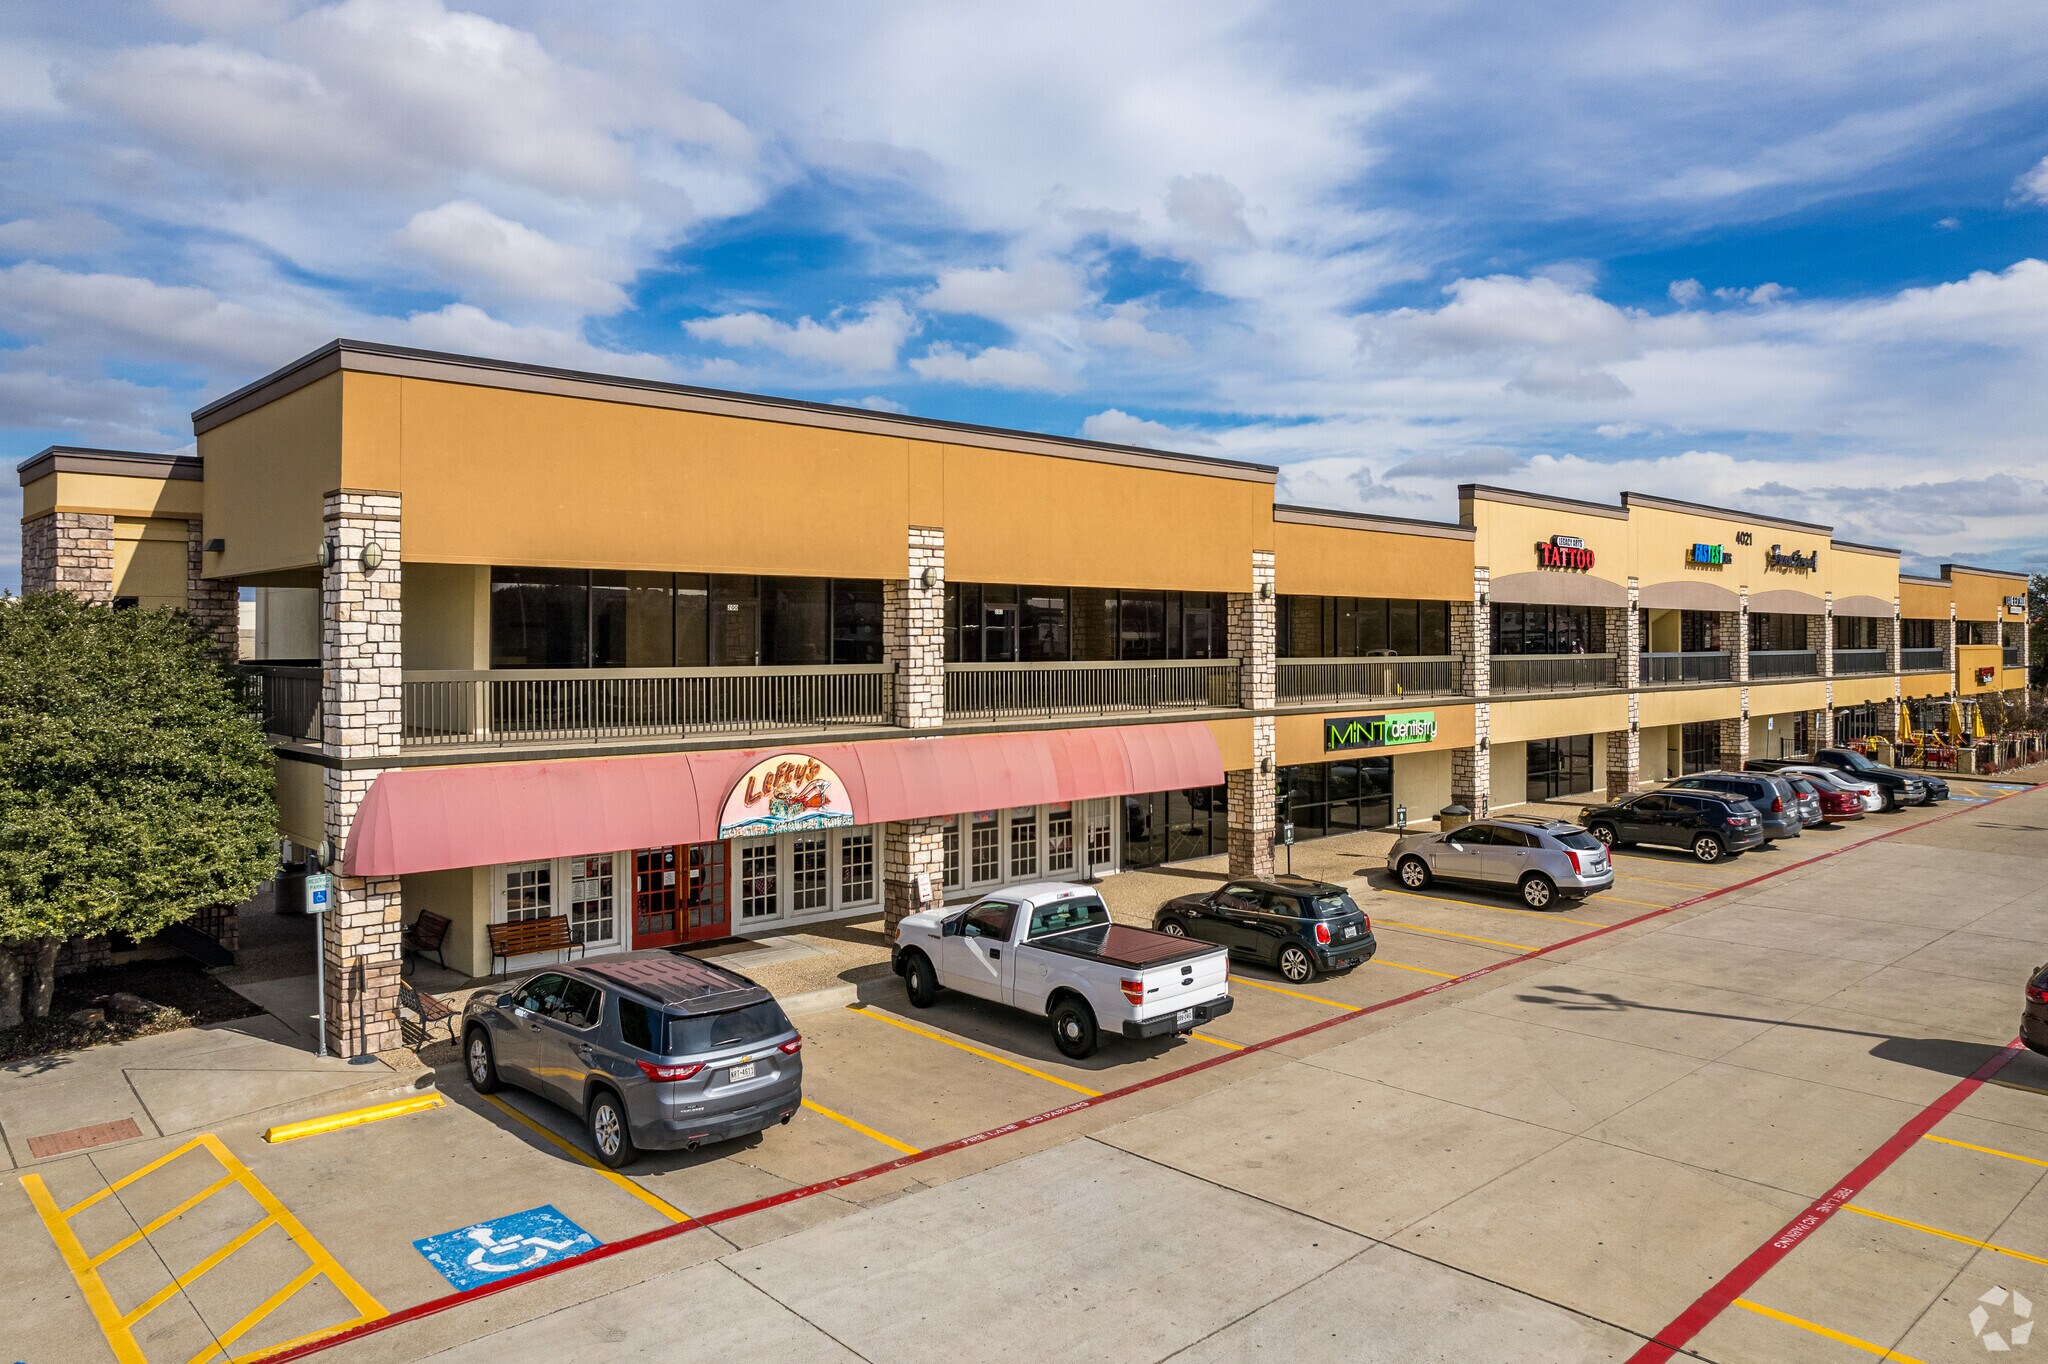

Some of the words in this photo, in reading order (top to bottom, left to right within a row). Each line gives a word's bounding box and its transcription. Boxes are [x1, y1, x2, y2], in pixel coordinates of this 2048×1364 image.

[1558, 537, 1572, 547] LEGACY
[1573, 539, 1583, 548] ARTS
[1735, 531, 1753, 546] 4021
[1541, 543, 1595, 569] TATTOO
[1694, 543, 1724, 564] FASTEST
[1391, 720, 1438, 738] dentistry
[987, 1124, 1019, 1135] LANE
[1025, 1116, 1044, 1124] NO
[1833, 1186, 1854, 1199] FIRE
[1816, 1198, 1840, 1213] LANE
[1802, 1214, 1819, 1225] NO
[1774, 1223, 1809, 1249] PARKING
